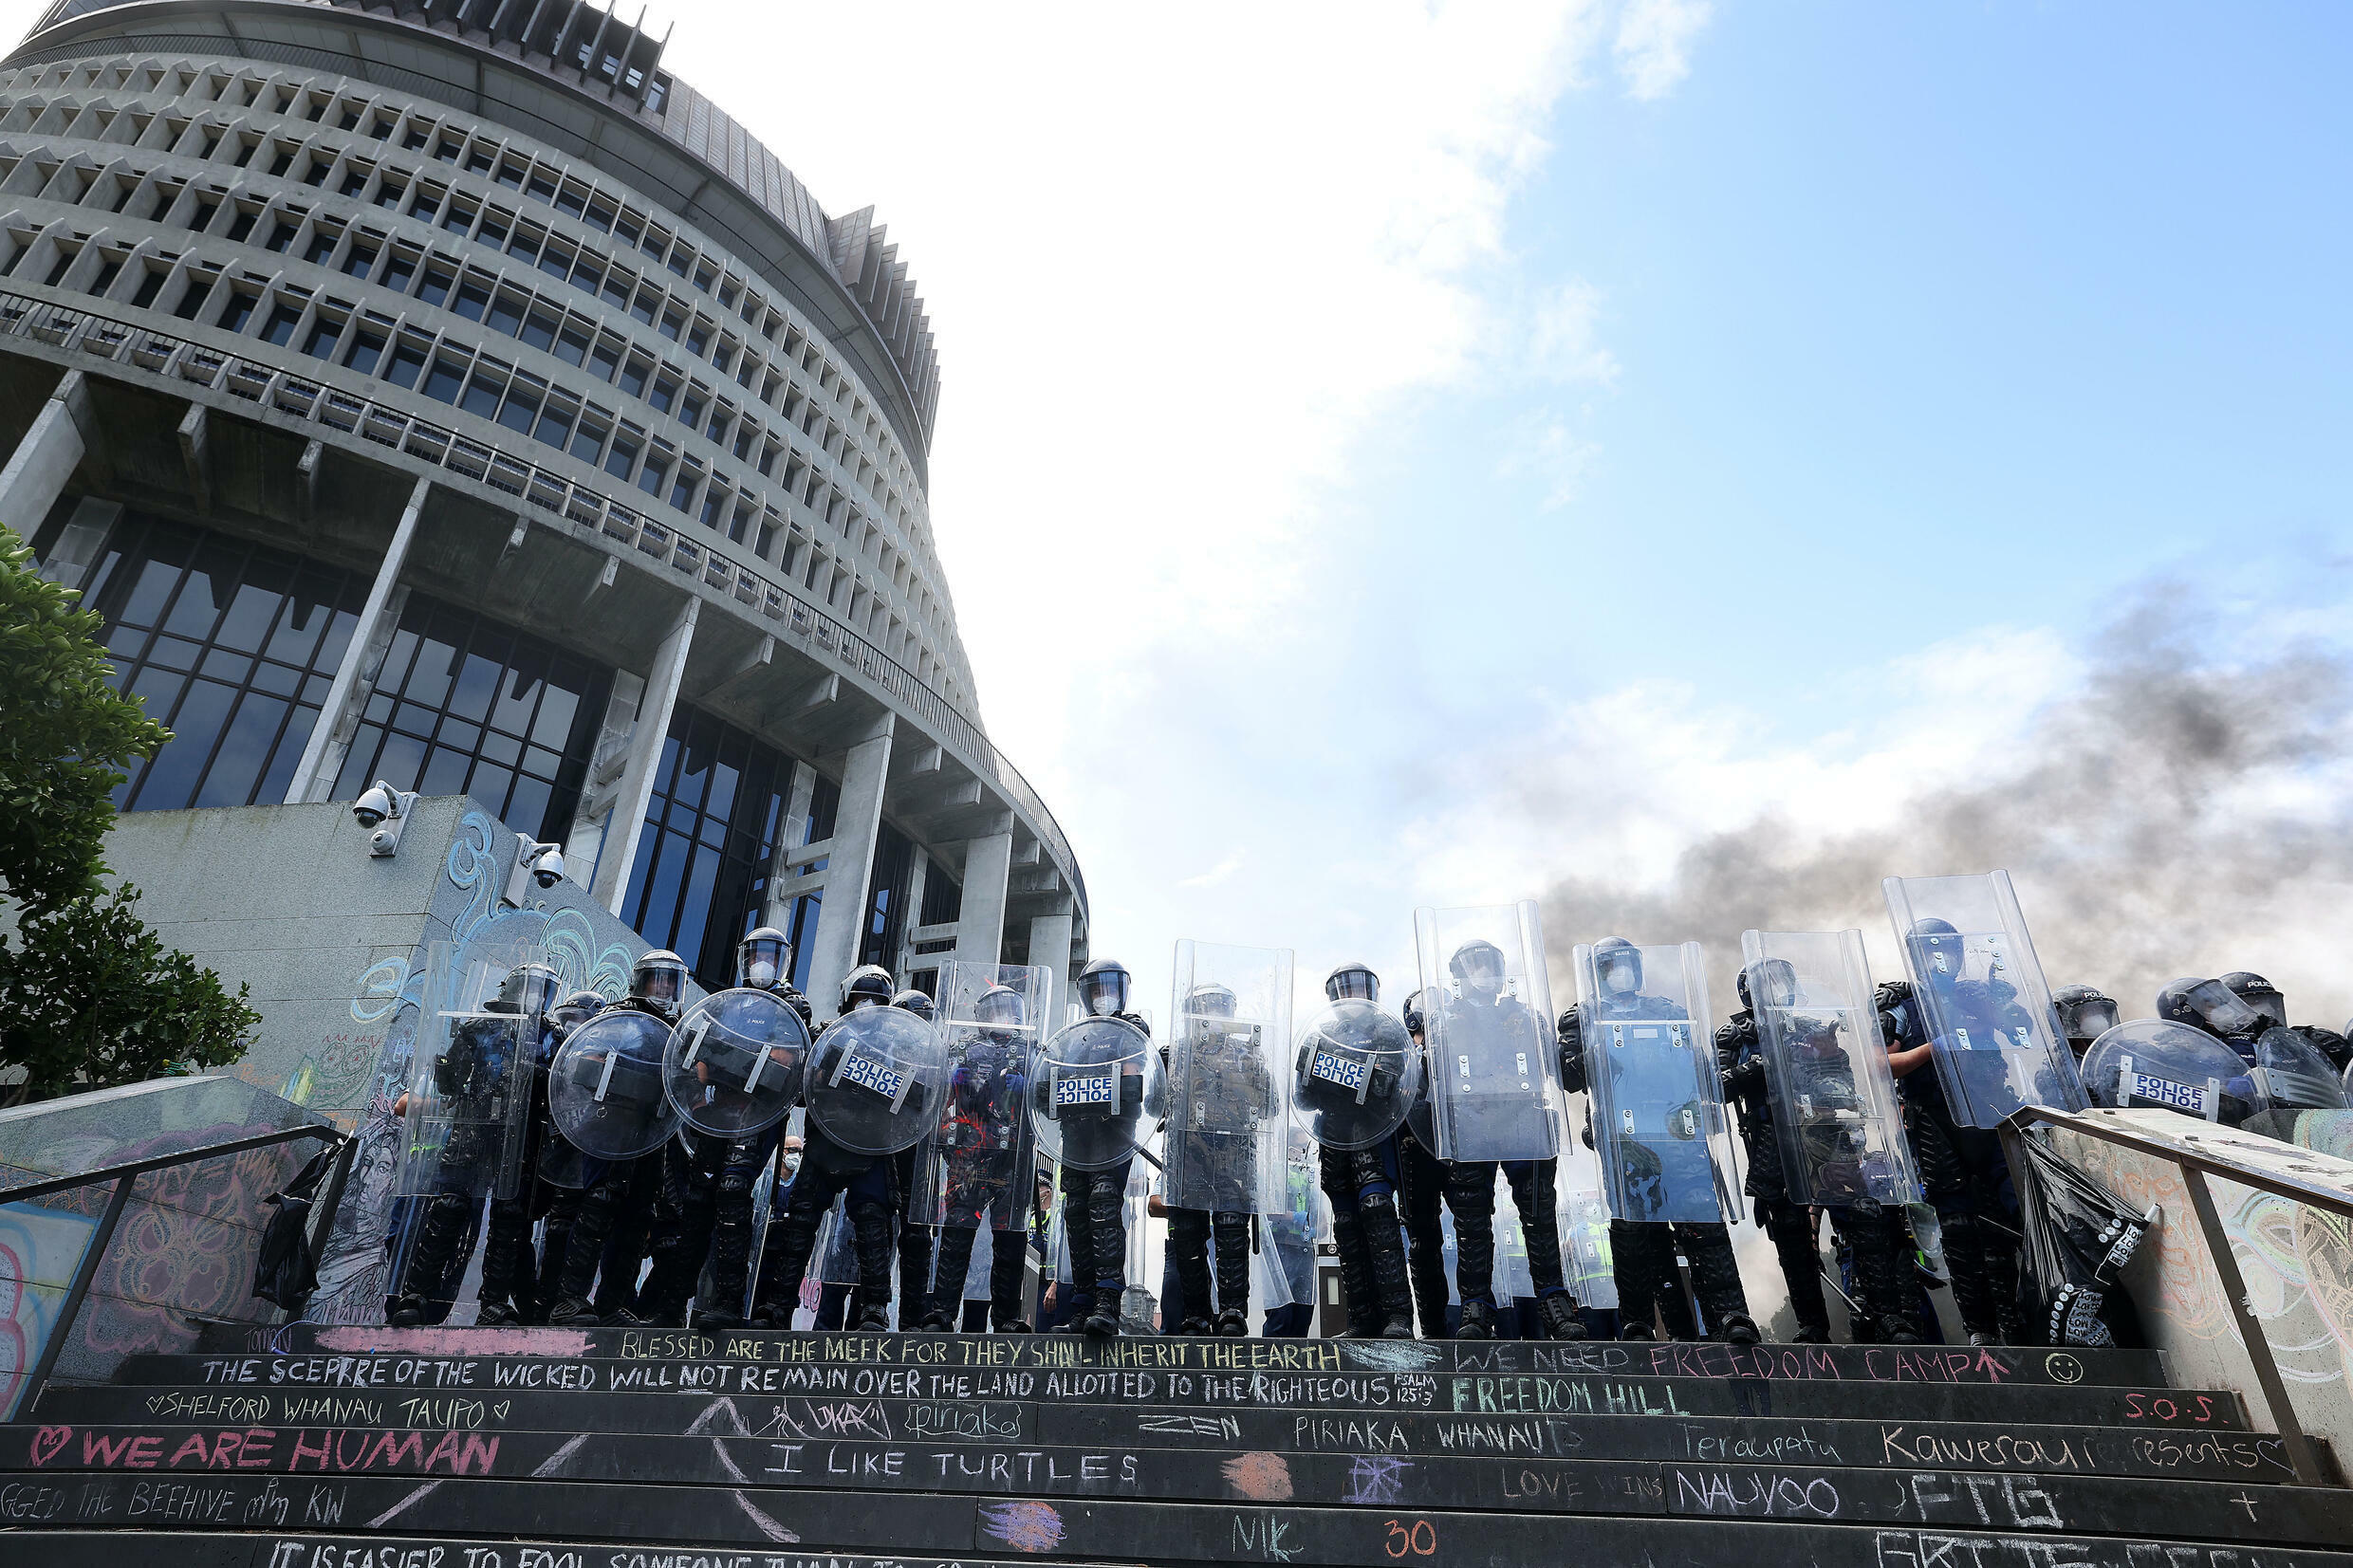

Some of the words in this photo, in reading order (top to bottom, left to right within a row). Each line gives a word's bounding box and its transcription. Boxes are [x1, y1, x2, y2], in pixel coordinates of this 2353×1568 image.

[847, 1055, 903, 1088] POLICE
[1316, 1053, 1366, 1079] POLICE
[1057, 1078, 1112, 1093] POLICE
[2137, 1075, 2203, 1099] POLICE
[621, 1330, 714, 1359] BLESSED
[726, 1338, 764, 1360] ARE
[773, 1338, 817, 1362] THE
[824, 1336, 892, 1362] MEEK
[901, 1339, 947, 1364] FOR
[957, 1338, 1025, 1367] THEY
[1100, 1342, 1189, 1368] INHERIT
[1195, 1343, 1248, 1369] THE
[1251, 1342, 1342, 1372] EARTH
[1454, 1343, 1519, 1374] WE
[1649, 1343, 1841, 1380] FREEDOM
[1865, 1348, 1971, 1383] CAMP
[201, 1358, 263, 1385] THE
[395, 1358, 432, 1385] OF
[434, 1360, 478, 1388] THE
[493, 1360, 596, 1391] WICKED
[610, 1365, 674, 1392] WILL
[678, 1364, 734, 1391] NOT
[740, 1365, 848, 1392] REMAIN
[853, 1368, 921, 1398] OVER
[930, 1374, 971, 1399] THE
[977, 1372, 1034, 1398] LAND
[1046, 1371, 1157, 1399] ALLOTTED
[1167, 1373, 1194, 1398] TO
[1201, 1374, 1248, 1403] THE
[1254, 1374, 1391, 1406] RIGHTEOUS
[1452, 1376, 1594, 1414] FREEDOM
[1605, 1383, 1690, 1415] HILL
[160, 1392, 271, 1422] SHELFORD
[284, 1396, 383, 1424] WHANAU
[398, 1396, 486, 1430] TAUPO
[82, 1430, 165, 1467] WE
[169, 1429, 277, 1469] ARE
[287, 1429, 501, 1476] HUMAN
[1294, 1416, 1410, 1452] PIRIAKA
[2083, 1432, 2259, 1468] reresents
[764, 1443, 805, 1474] I
[827, 1442, 906, 1476] LIKE
[930, 1450, 1139, 1483] TURTLES
[127, 1481, 235, 1522] BEEHIVE
[1502, 1467, 1584, 1499] LOVE
[268, 1540, 306, 1568] IT
[310, 1545, 338, 1568] IS
[1383, 1520, 1437, 1559] 30
